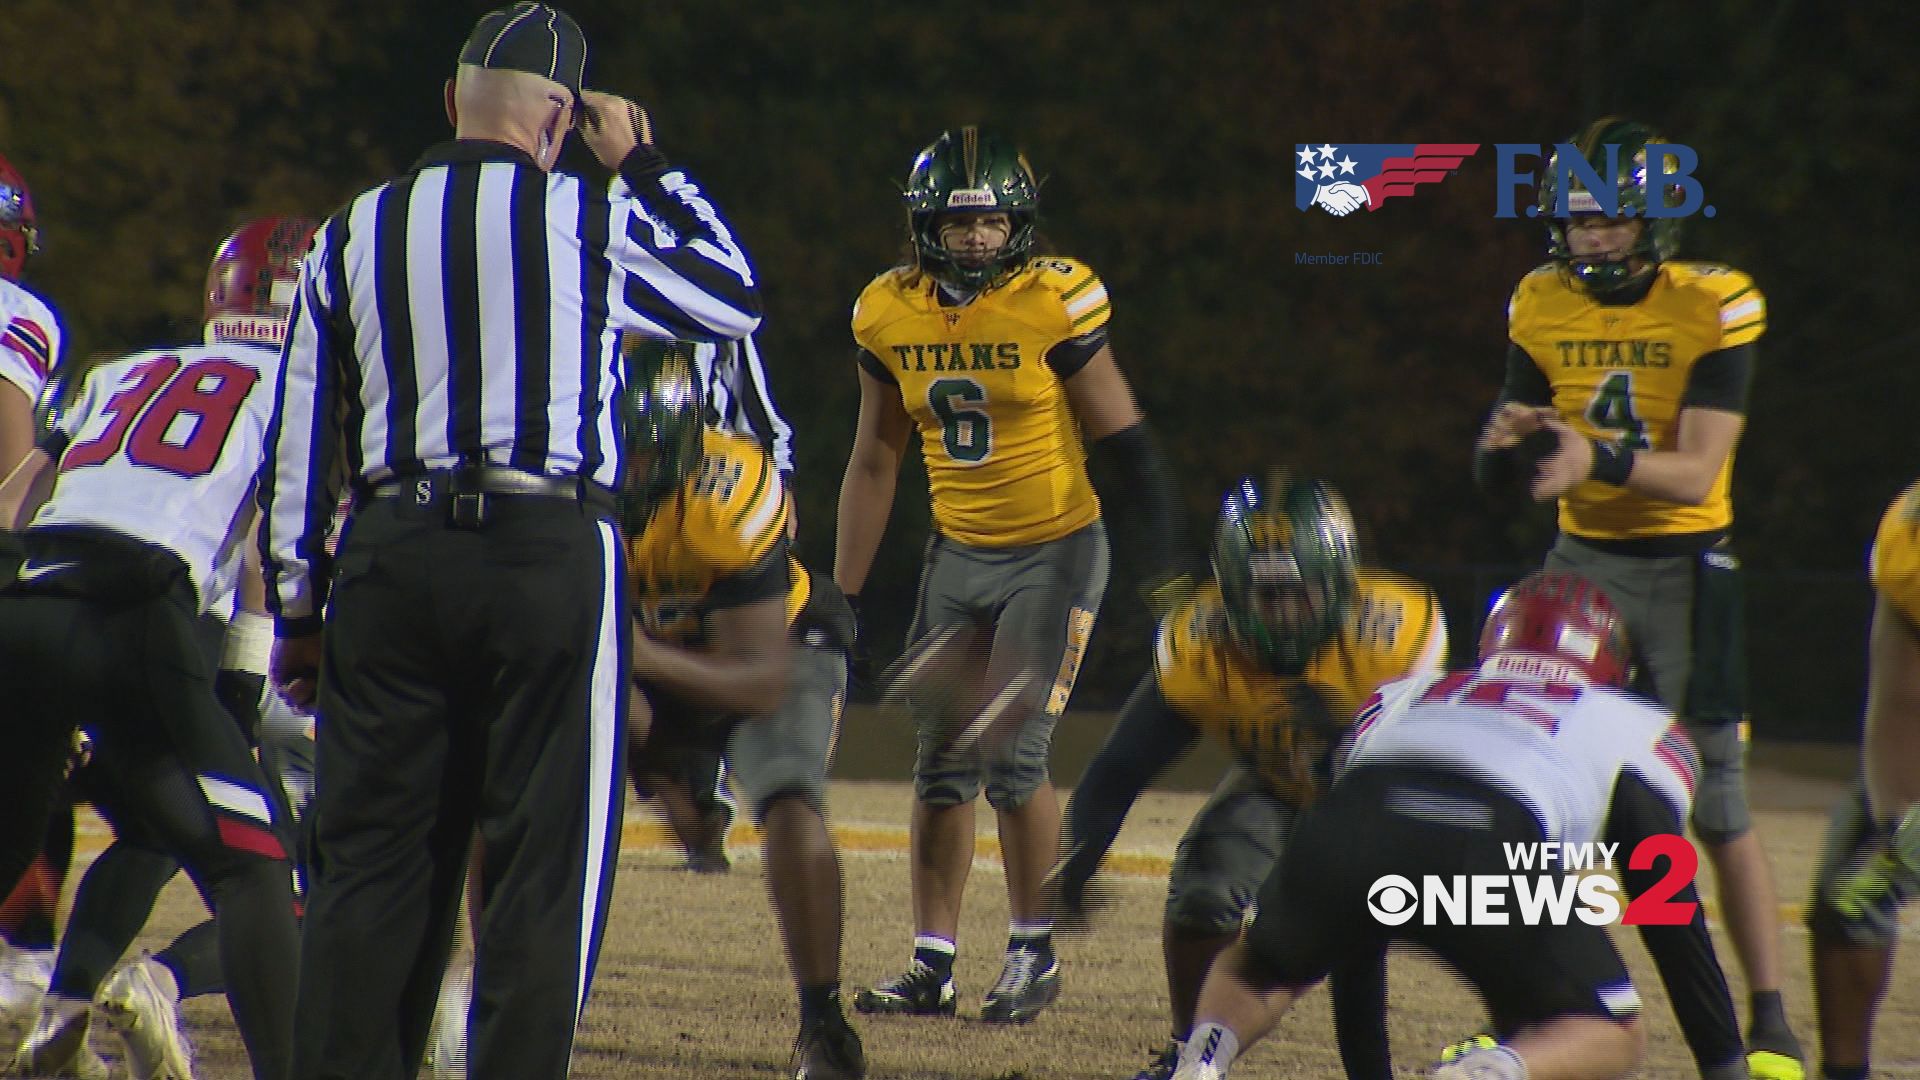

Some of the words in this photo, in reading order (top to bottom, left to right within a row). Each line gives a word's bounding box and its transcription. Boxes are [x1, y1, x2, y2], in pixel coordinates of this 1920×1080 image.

[952, 193, 992, 204] Riddell
[891, 342, 1021, 372] TITANS
[1556, 340, 1673, 368] TITANS
[58, 354, 262, 480] 38
[926, 377, 993, 465] 6
[1585, 369, 1652, 451] 4
